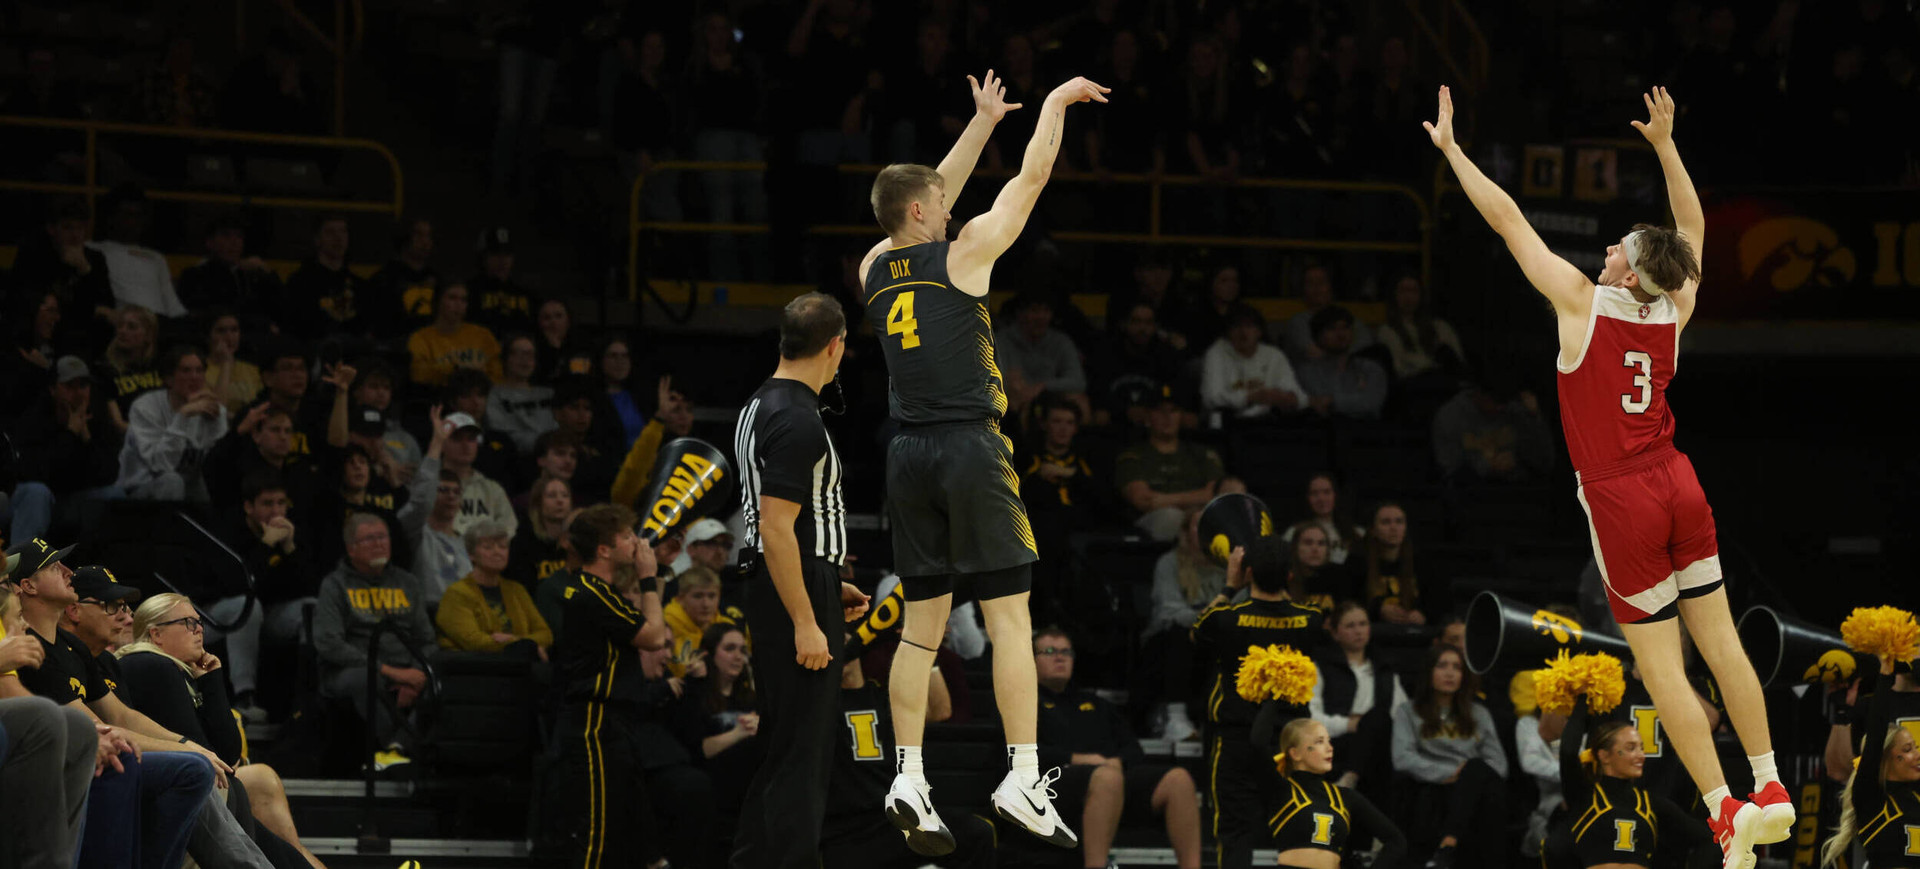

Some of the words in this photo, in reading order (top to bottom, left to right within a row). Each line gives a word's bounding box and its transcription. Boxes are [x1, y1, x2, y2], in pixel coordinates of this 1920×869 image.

[888, 258, 912, 280] DIX
[886, 290, 921, 350] 4
[1621, 350, 1652, 414] 3
[643, 452, 724, 539] IOWA
[347, 588, 411, 609] IOWA
[1236, 613, 1310, 629] HAWKEYES
[844, 709, 884, 761] I
[1629, 705, 1663, 758] I
[1311, 812, 1334, 845] I
[1614, 818, 1637, 852] I
